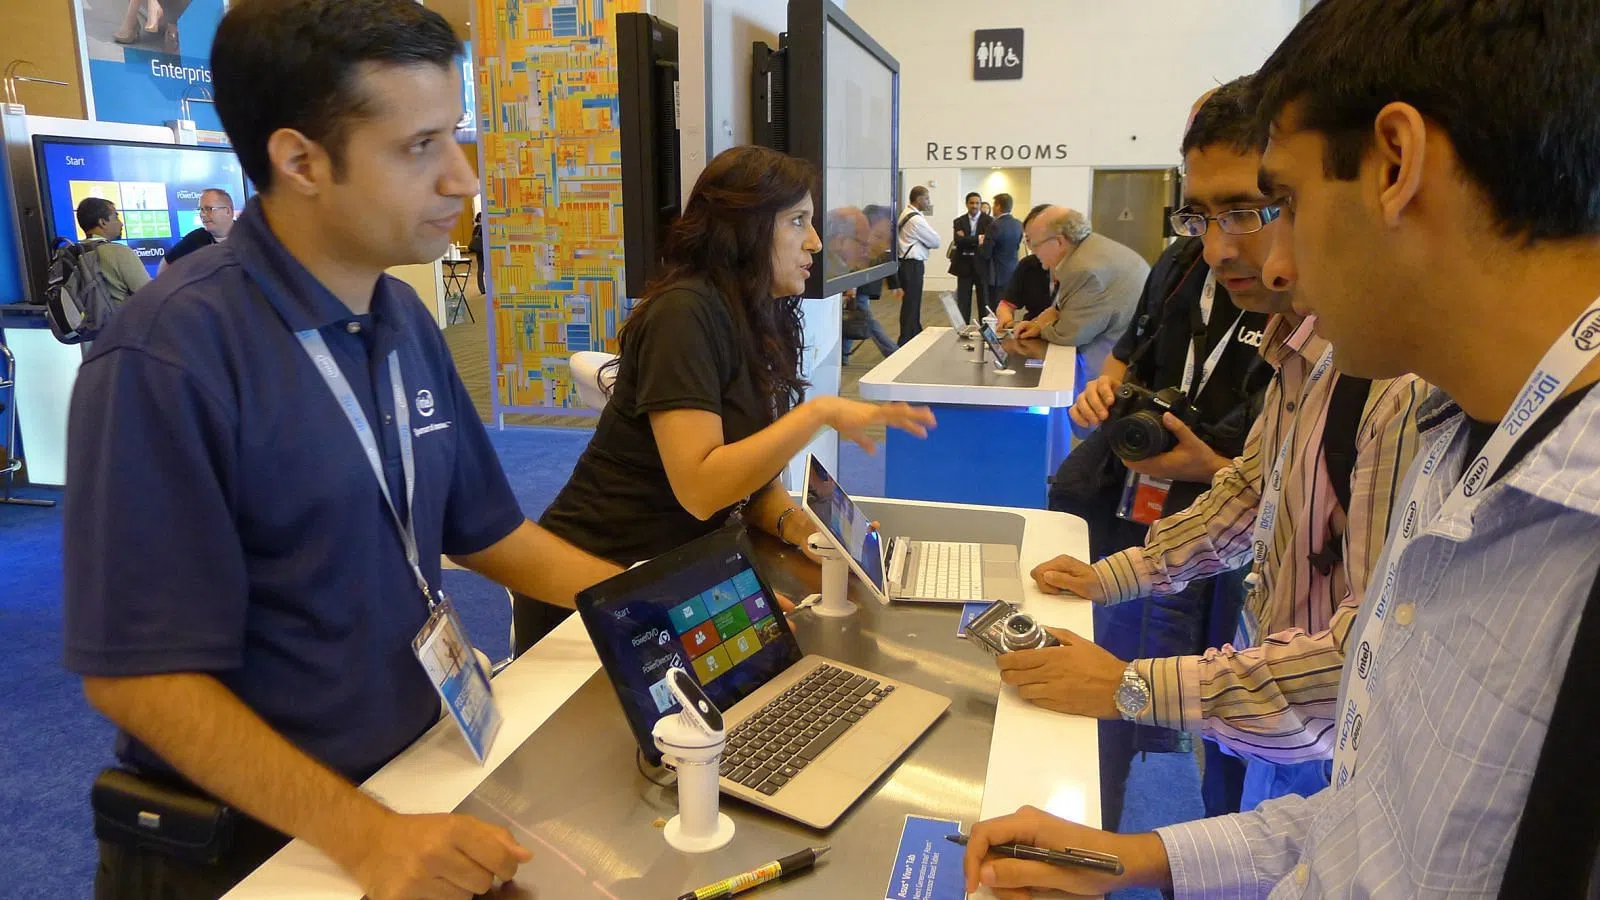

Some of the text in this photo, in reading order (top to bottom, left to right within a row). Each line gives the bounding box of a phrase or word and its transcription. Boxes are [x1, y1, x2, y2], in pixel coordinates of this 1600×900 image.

[151, 58, 213, 85] Enterpris
[65, 155, 86, 167] Start
[927, 141, 1068, 161] RESTROOMS
[1575, 311, 1600, 348] ntel
[1506, 374, 1560, 436] IDF2012
[1464, 458, 1488, 495] intel
[1404, 502, 1416, 536] intel
[1375, 562, 1397, 618] IDF2012
[614, 607, 632, 620] Start
[631, 628, 659, 647] PowerDVD
[1357, 643, 1371, 677] intel
[905, 854, 916, 864] Tab
